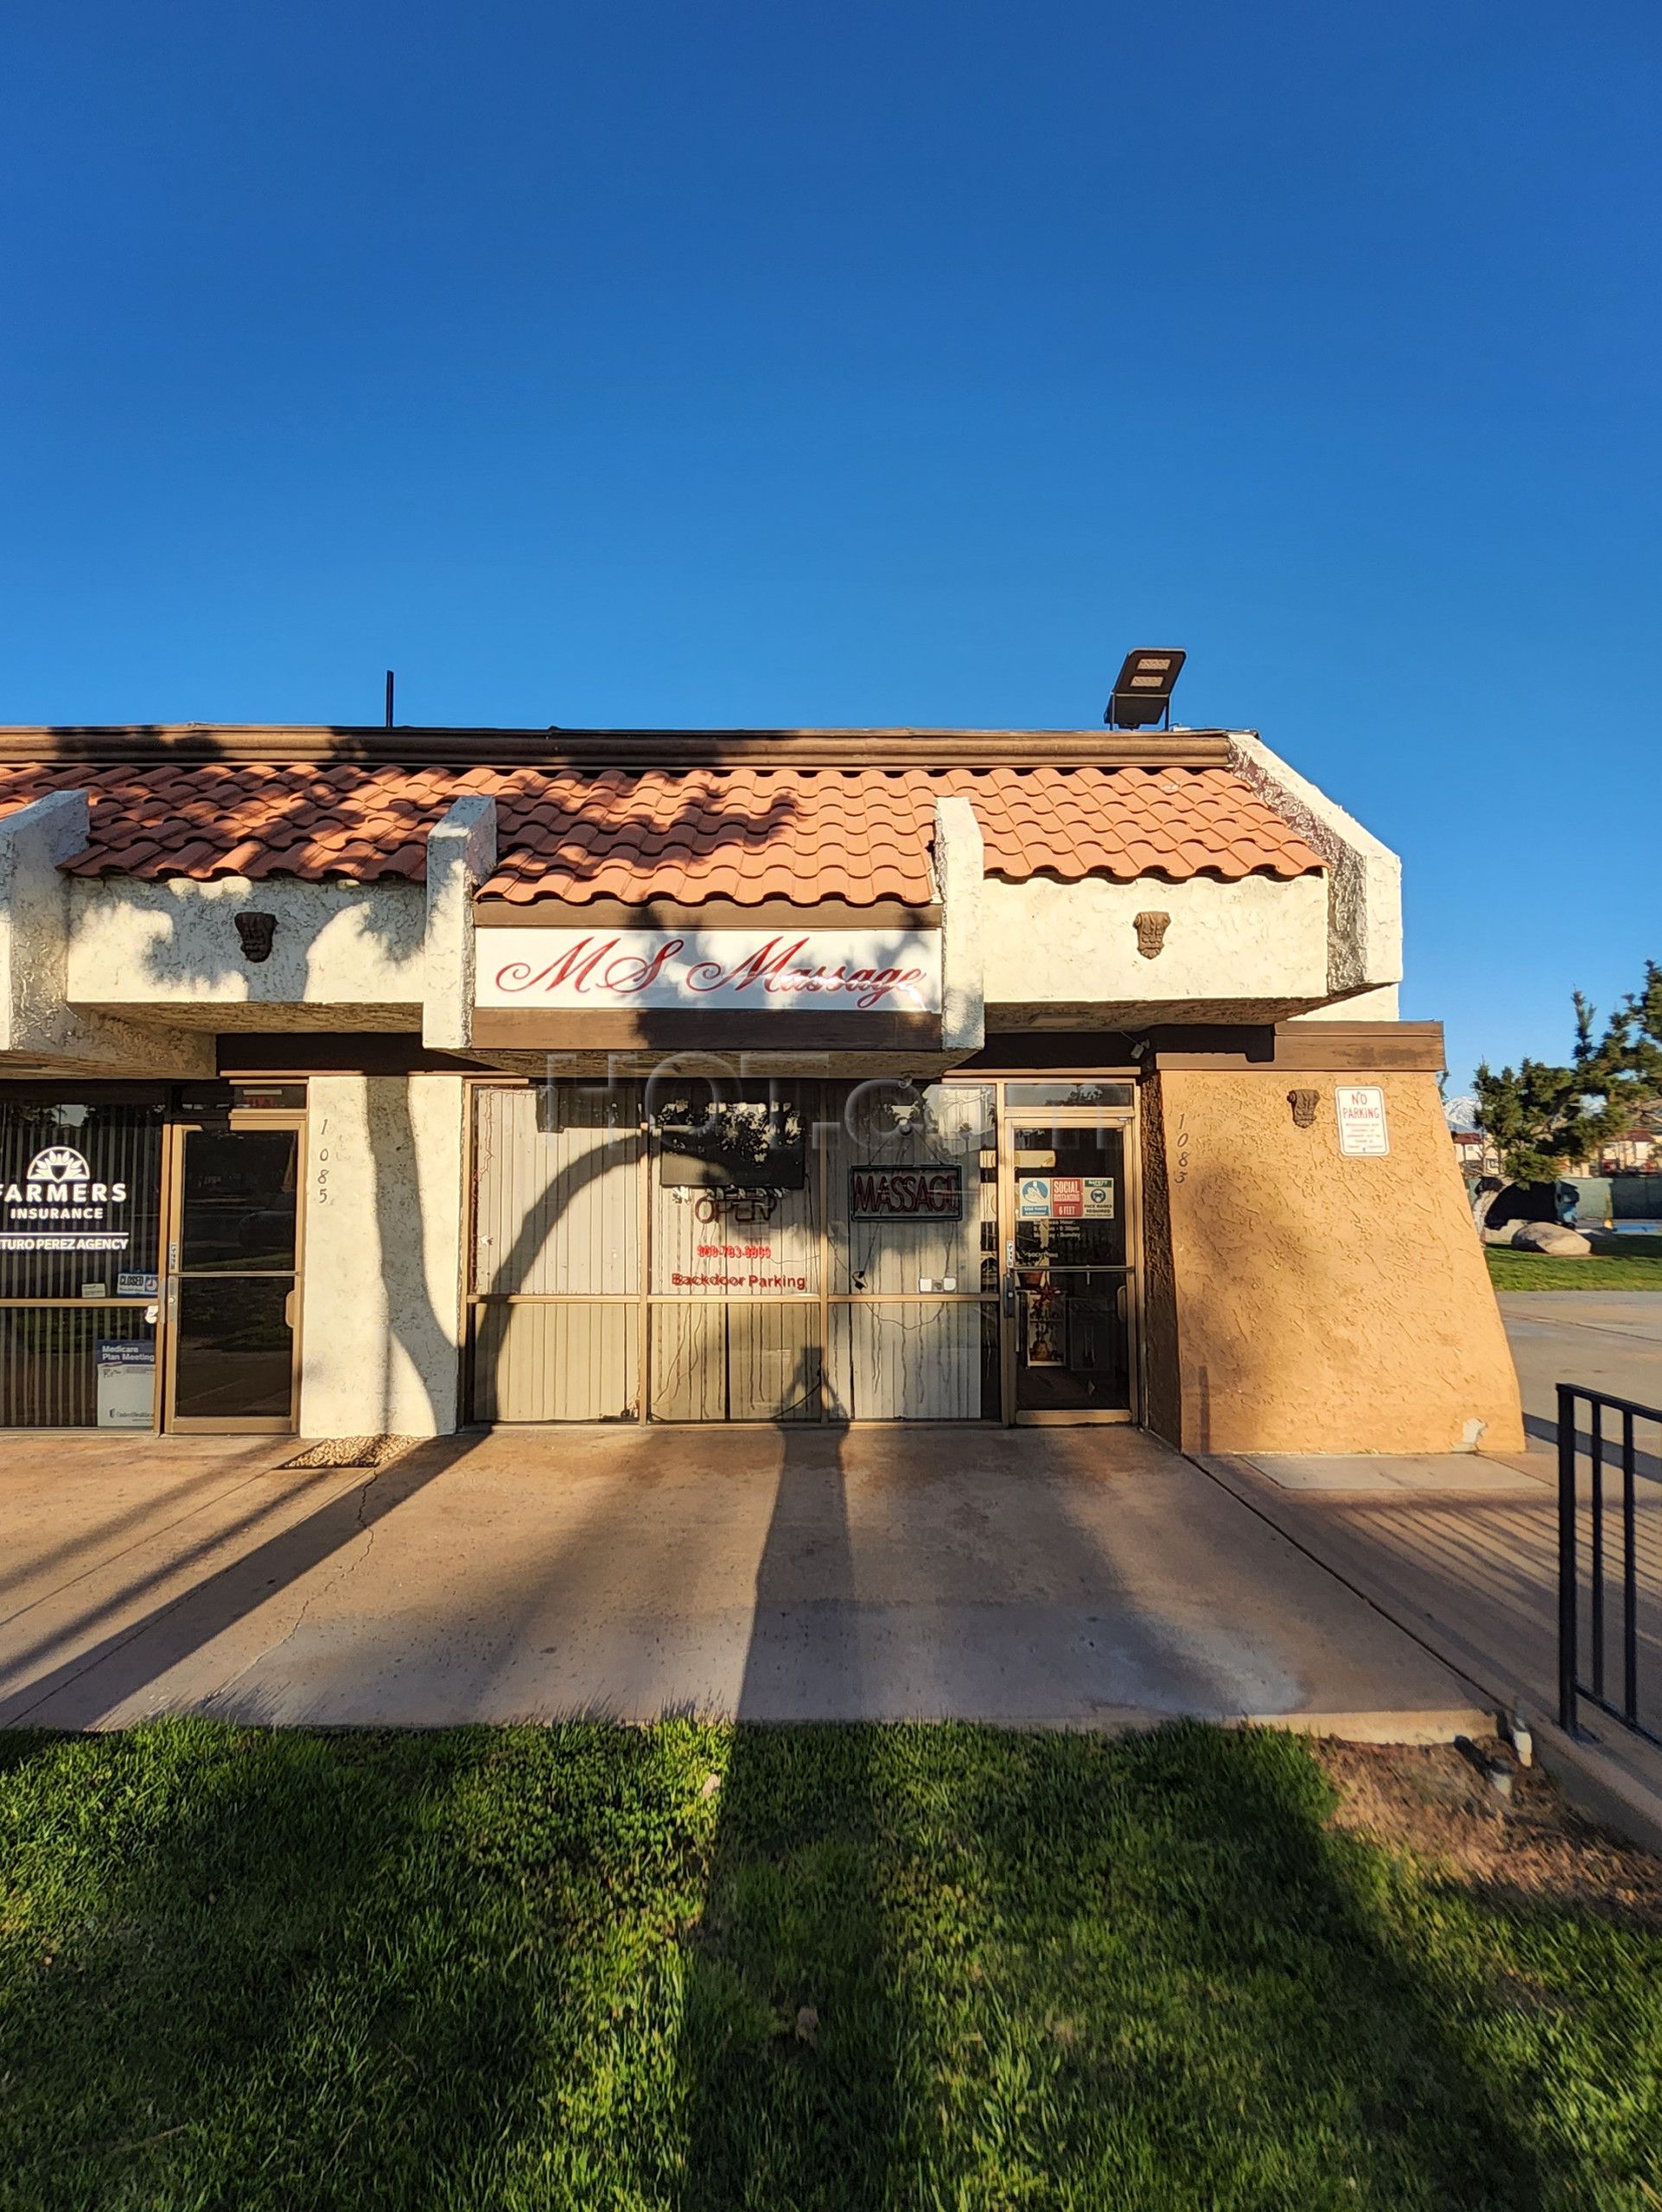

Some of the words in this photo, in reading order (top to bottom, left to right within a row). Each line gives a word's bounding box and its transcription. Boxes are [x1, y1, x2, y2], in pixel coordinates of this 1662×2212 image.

[496, 936, 685, 993] MS
[686, 935, 927, 1008] Massage
[1352, 1094, 1367, 1105] NO
[1343, 1108, 1379, 1119] PARKING
[0, 1183, 126, 1202] ARMERS
[1054, 1180, 1080, 1193] SOCIAL
[10, 1208, 104, 1219] INSURANCE
[0, 1238, 35, 1250] TURO
[36, 1238, 75, 1250] PEREZ
[76, 1238, 129, 1250] AGENCY
[672, 1273, 745, 1287] Backdoor
[748, 1274, 806, 1290] Parking
[122, 1353, 155, 1362] Meeting
